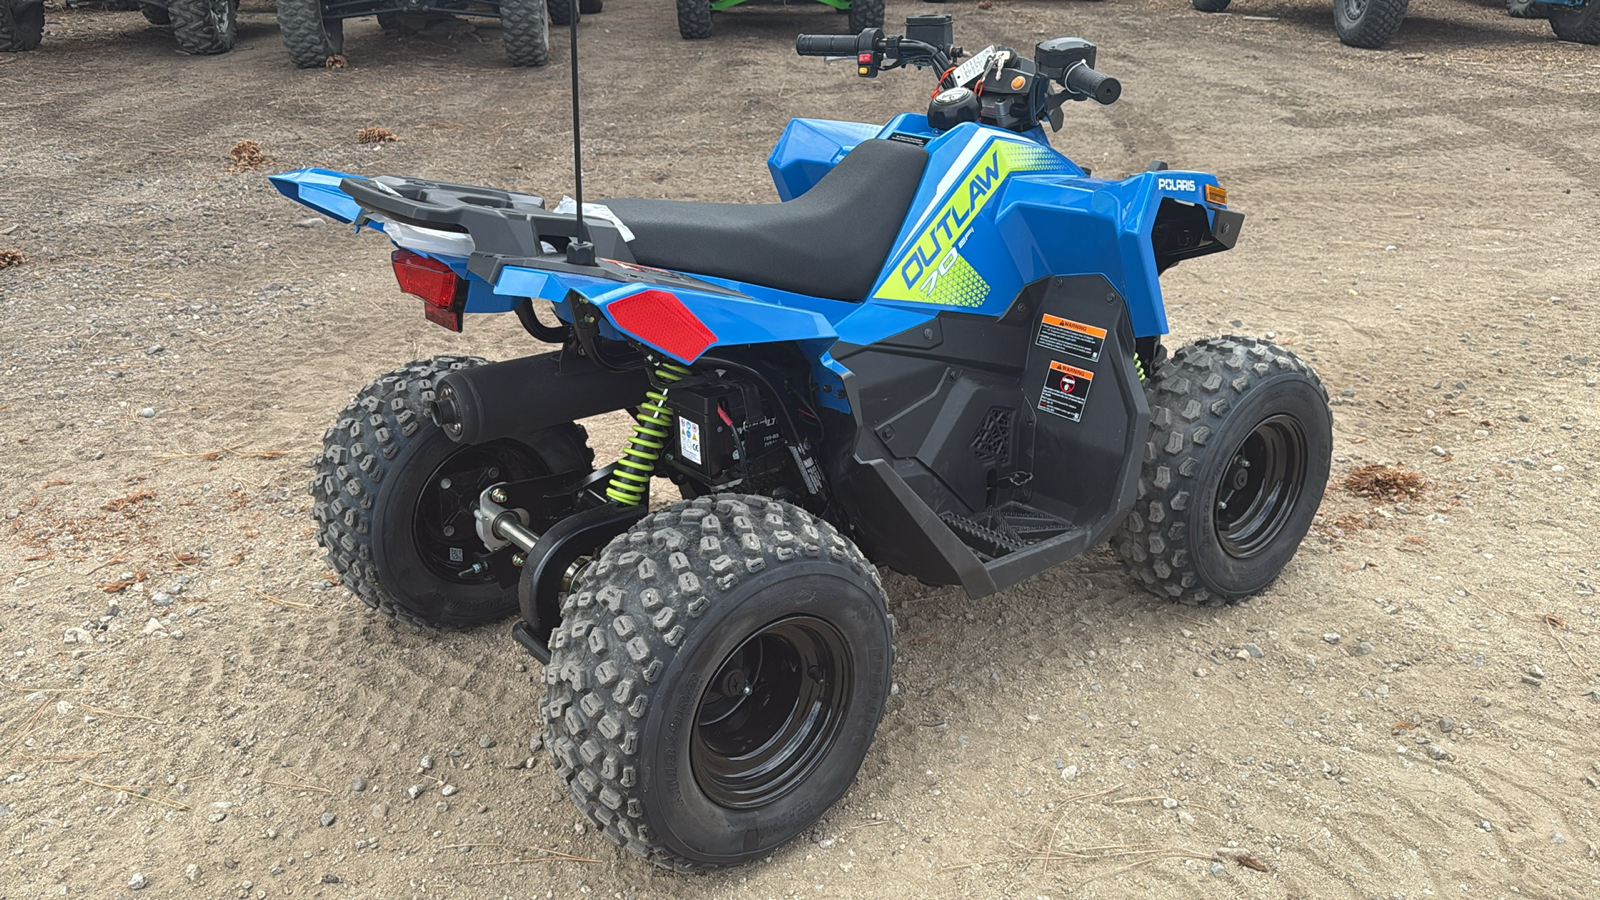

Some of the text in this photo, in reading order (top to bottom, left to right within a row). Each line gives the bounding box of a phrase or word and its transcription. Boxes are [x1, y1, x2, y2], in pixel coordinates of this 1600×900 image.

[1158, 178, 1196, 192] POLARIS
[901, 149, 1000, 290] OUTLAW
[919, 246, 959, 297] 70
[1064, 320, 1087, 332] WARNING
[1062, 365, 1085, 377] WARNING
